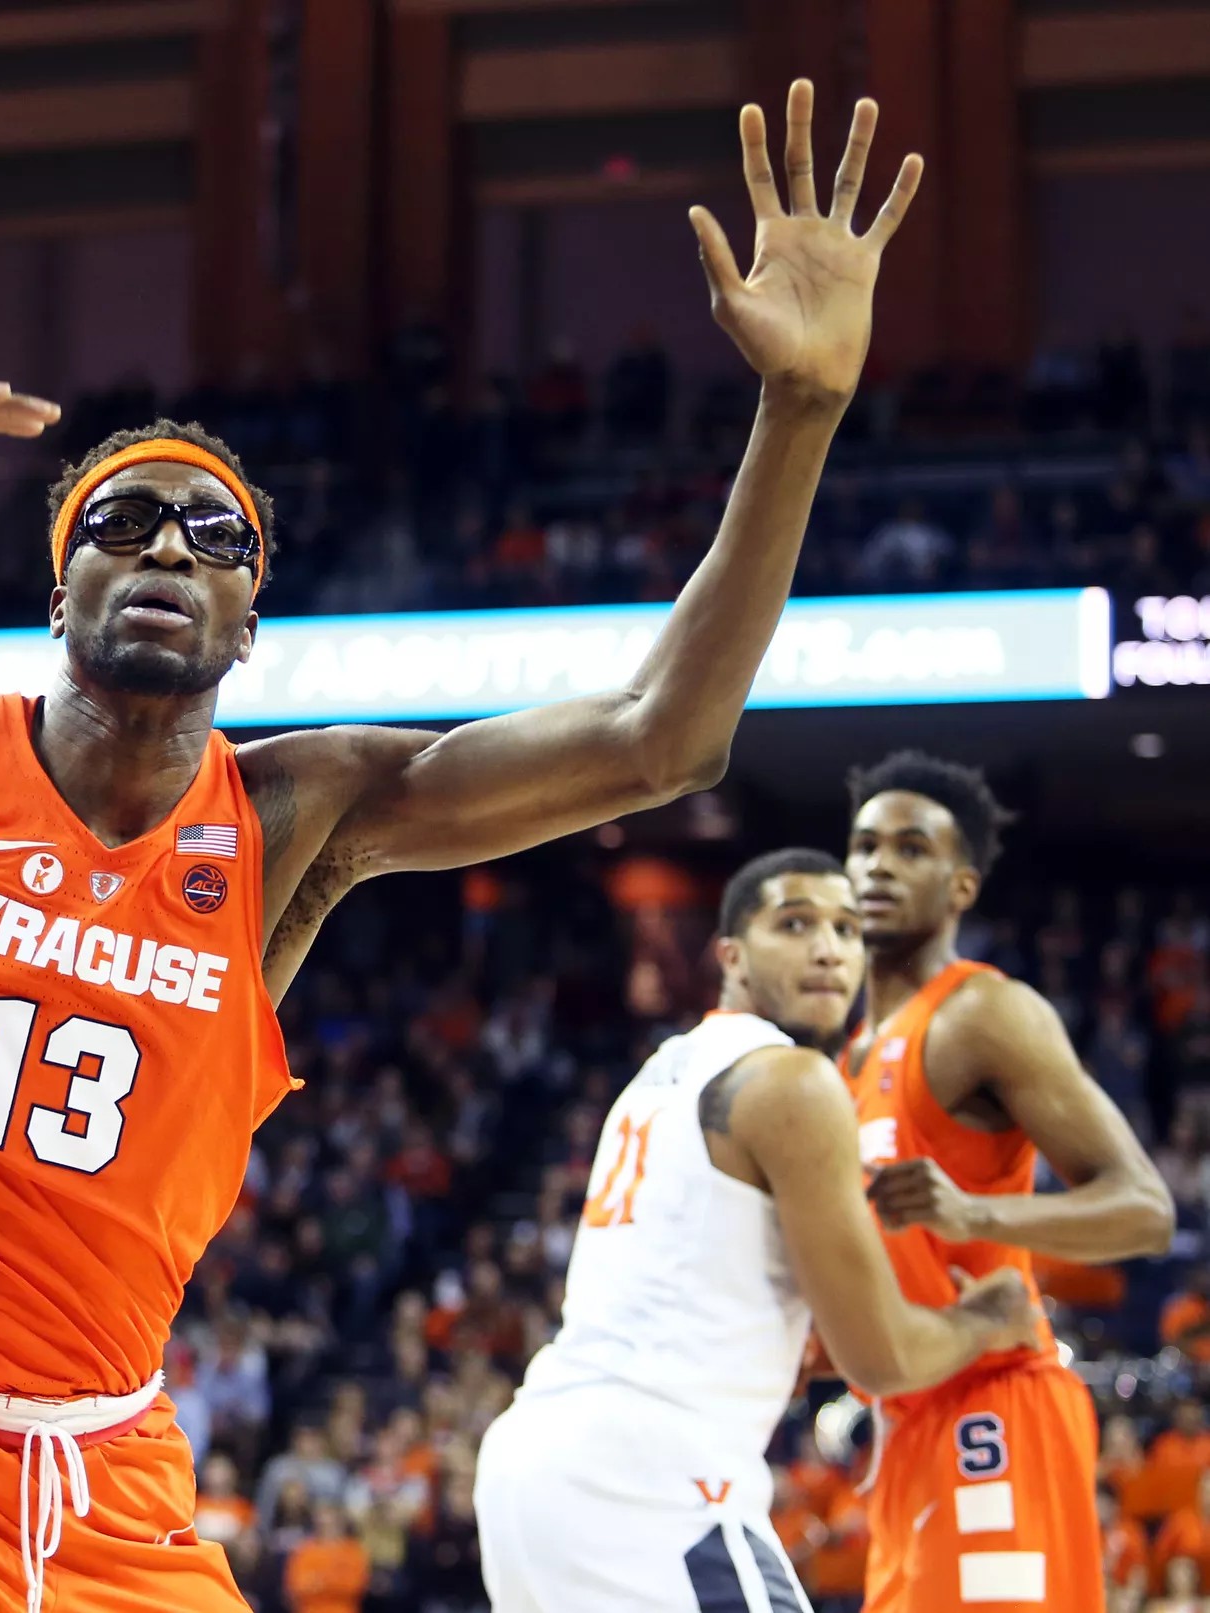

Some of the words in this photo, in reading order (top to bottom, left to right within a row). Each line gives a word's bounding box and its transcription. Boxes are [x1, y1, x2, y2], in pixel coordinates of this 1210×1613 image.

[31, 869, 50, 891] K
[189, 879, 223, 892] ACC
[955, 1412, 1008, 1479] S
